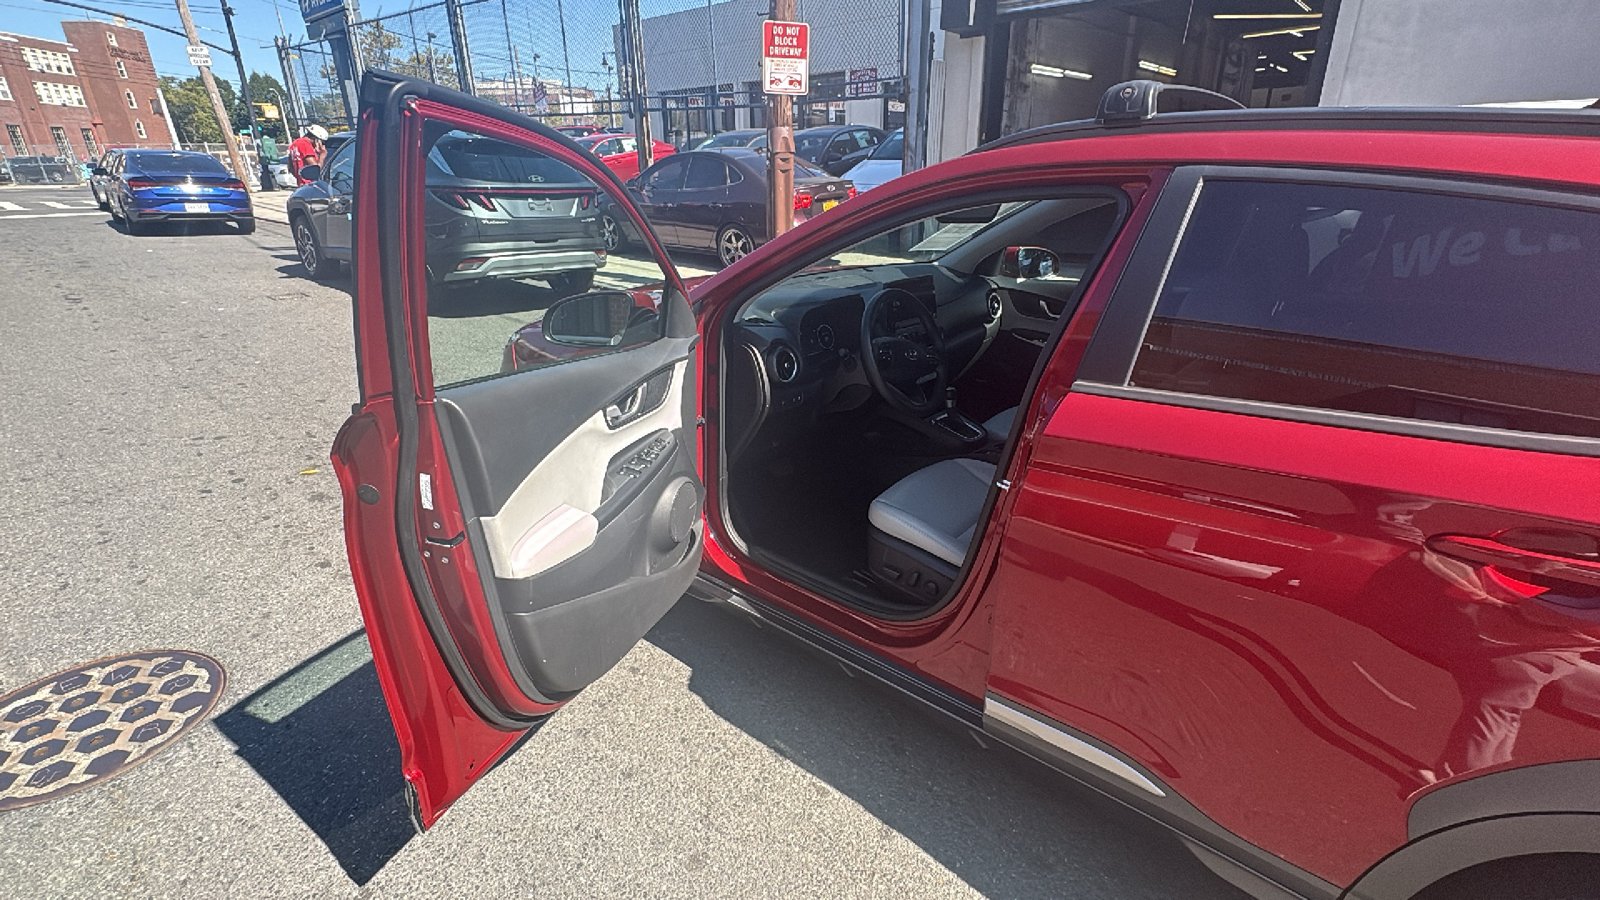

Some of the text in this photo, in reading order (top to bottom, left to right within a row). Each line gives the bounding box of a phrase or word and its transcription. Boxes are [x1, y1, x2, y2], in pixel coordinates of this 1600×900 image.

[773, 25, 800, 36] DO NOT
[774, 36, 798, 46] BLOCK
[769, 46, 803, 57] DRIVEWAY
